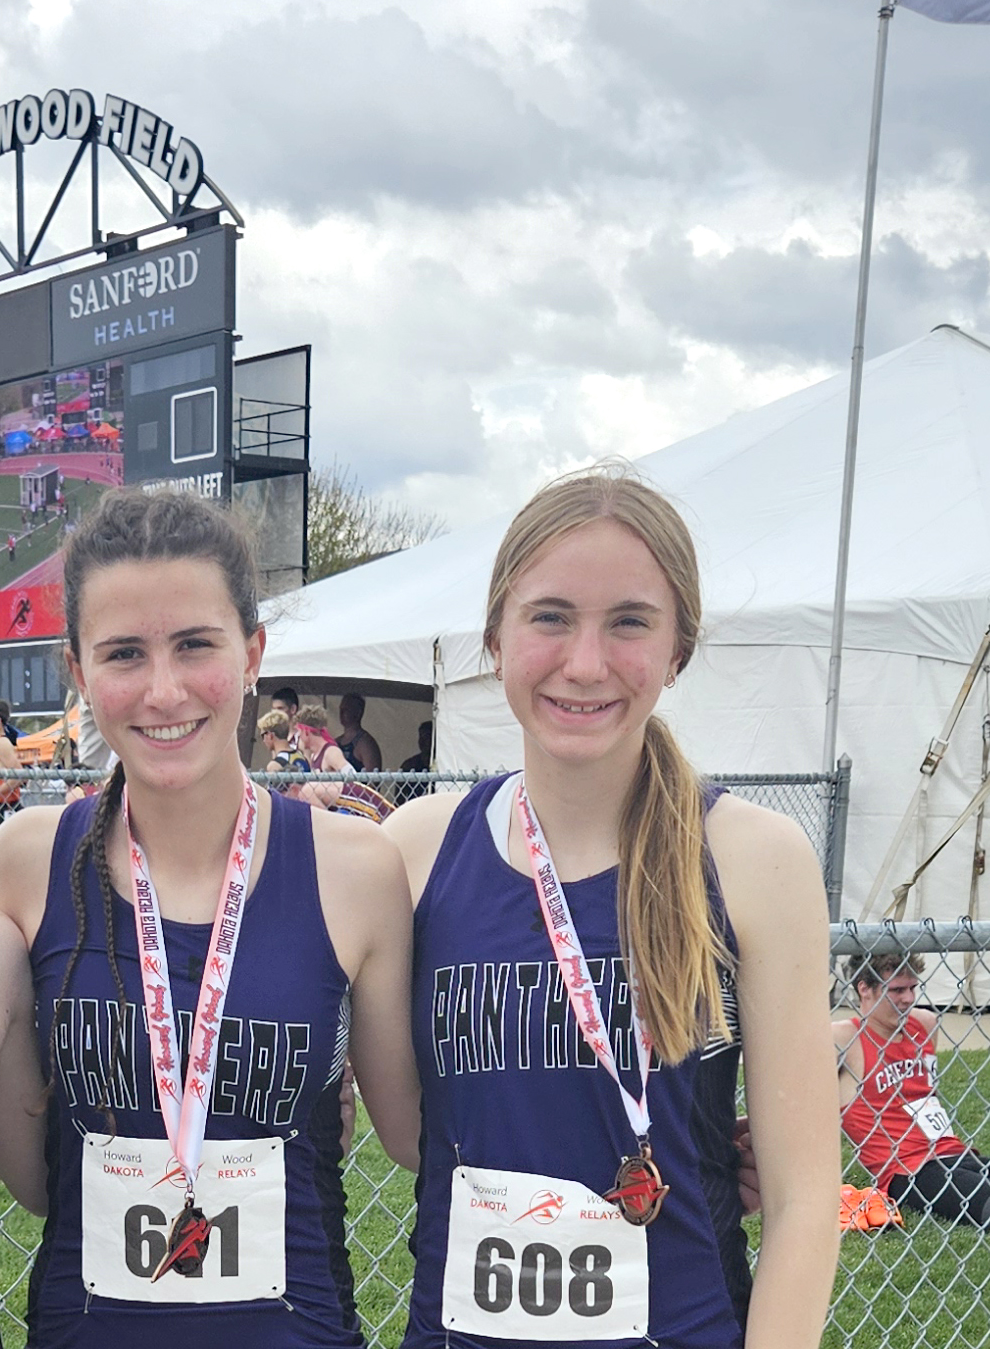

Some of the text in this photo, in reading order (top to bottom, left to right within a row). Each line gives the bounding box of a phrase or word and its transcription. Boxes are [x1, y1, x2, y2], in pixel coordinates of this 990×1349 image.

[99, 93, 203, 195] FIELD
[94, 306, 174, 346] HEALTH
[197, 472, 223, 499] LEFT
[432, 958, 662, 1077] PANTHR
[53, 998, 310, 1125] PANERS
[103, 1164, 256, 1179] DAKOTA RELAYS
[104, 1150, 253, 1164] Howard Wood
[472, 1182, 507, 1196] Howard
[470, 1199, 621, 1220] DAKOTA RELAYS
[124, 1204, 239, 1278] 61
[473, 1236, 614, 1317] 608
